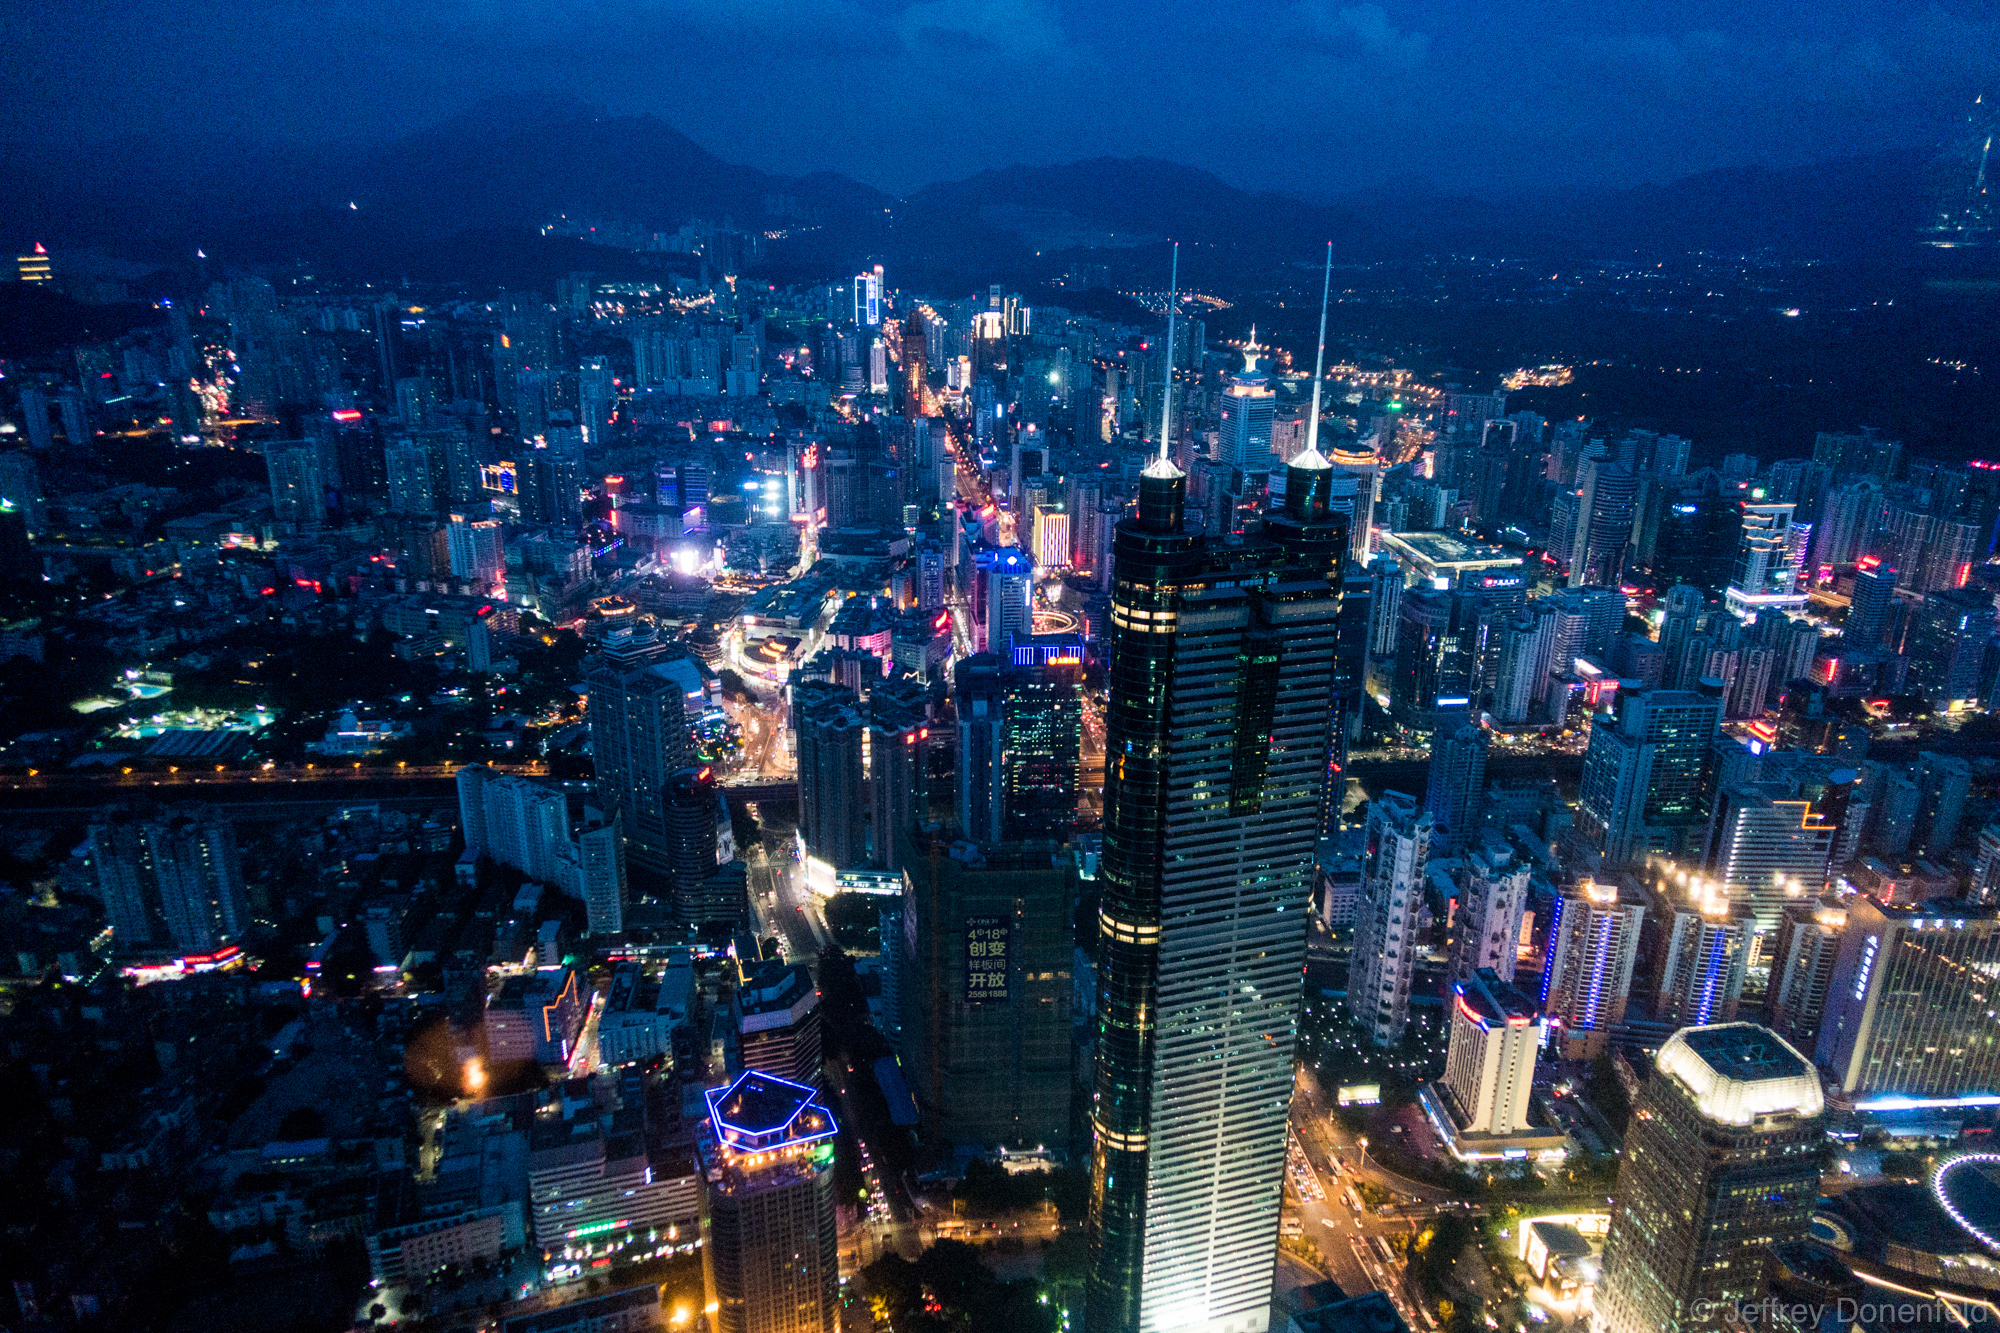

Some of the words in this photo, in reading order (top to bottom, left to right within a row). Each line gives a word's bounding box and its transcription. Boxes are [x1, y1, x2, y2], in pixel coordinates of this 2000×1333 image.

[969, 941, 1006, 957] 创变
[969, 959, 1006, 971] 样板间
[969, 972, 1006, 988] 开放
